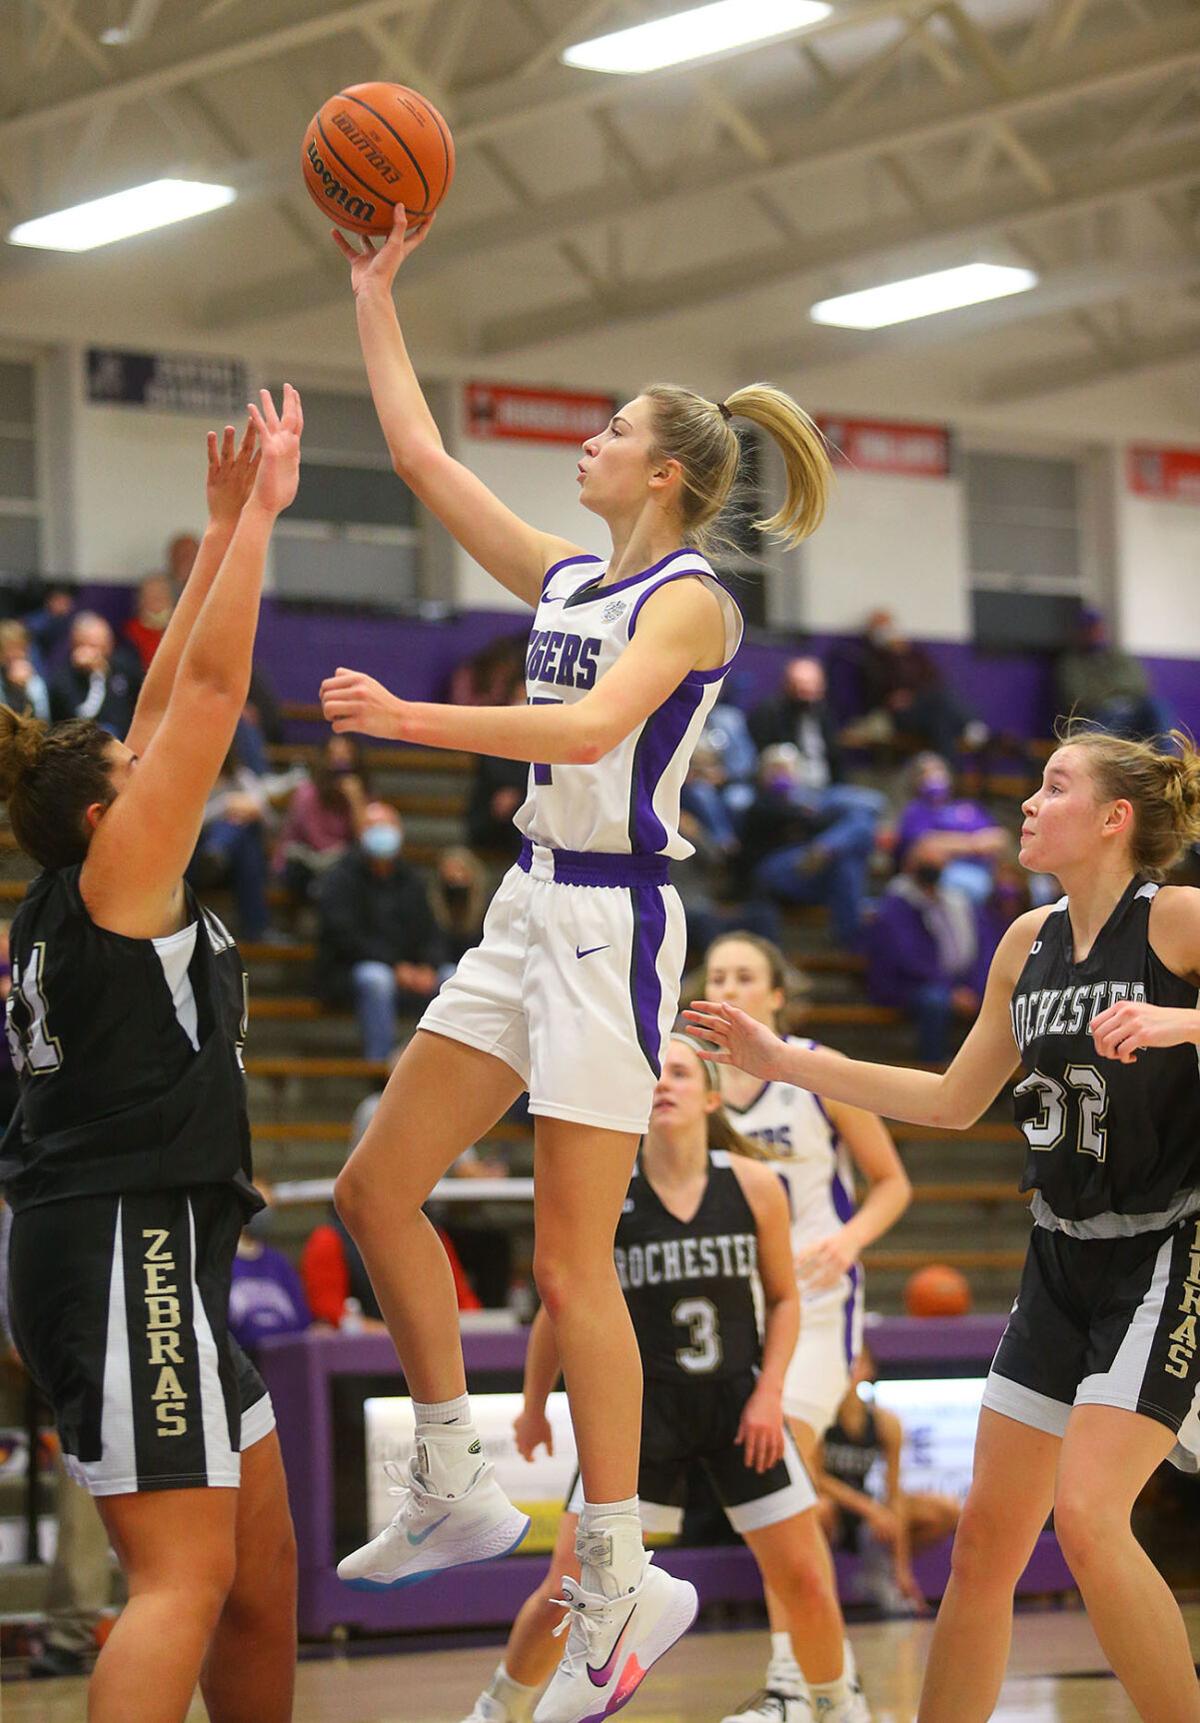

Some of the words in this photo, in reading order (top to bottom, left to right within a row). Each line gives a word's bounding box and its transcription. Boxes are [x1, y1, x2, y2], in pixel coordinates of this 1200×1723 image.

[306, 136, 376, 222] Wilson
[1013, 1064, 1109, 1163] 32
[142, 1228, 188, 1438] ZEBRAS
[671, 1296, 723, 1376] 3
